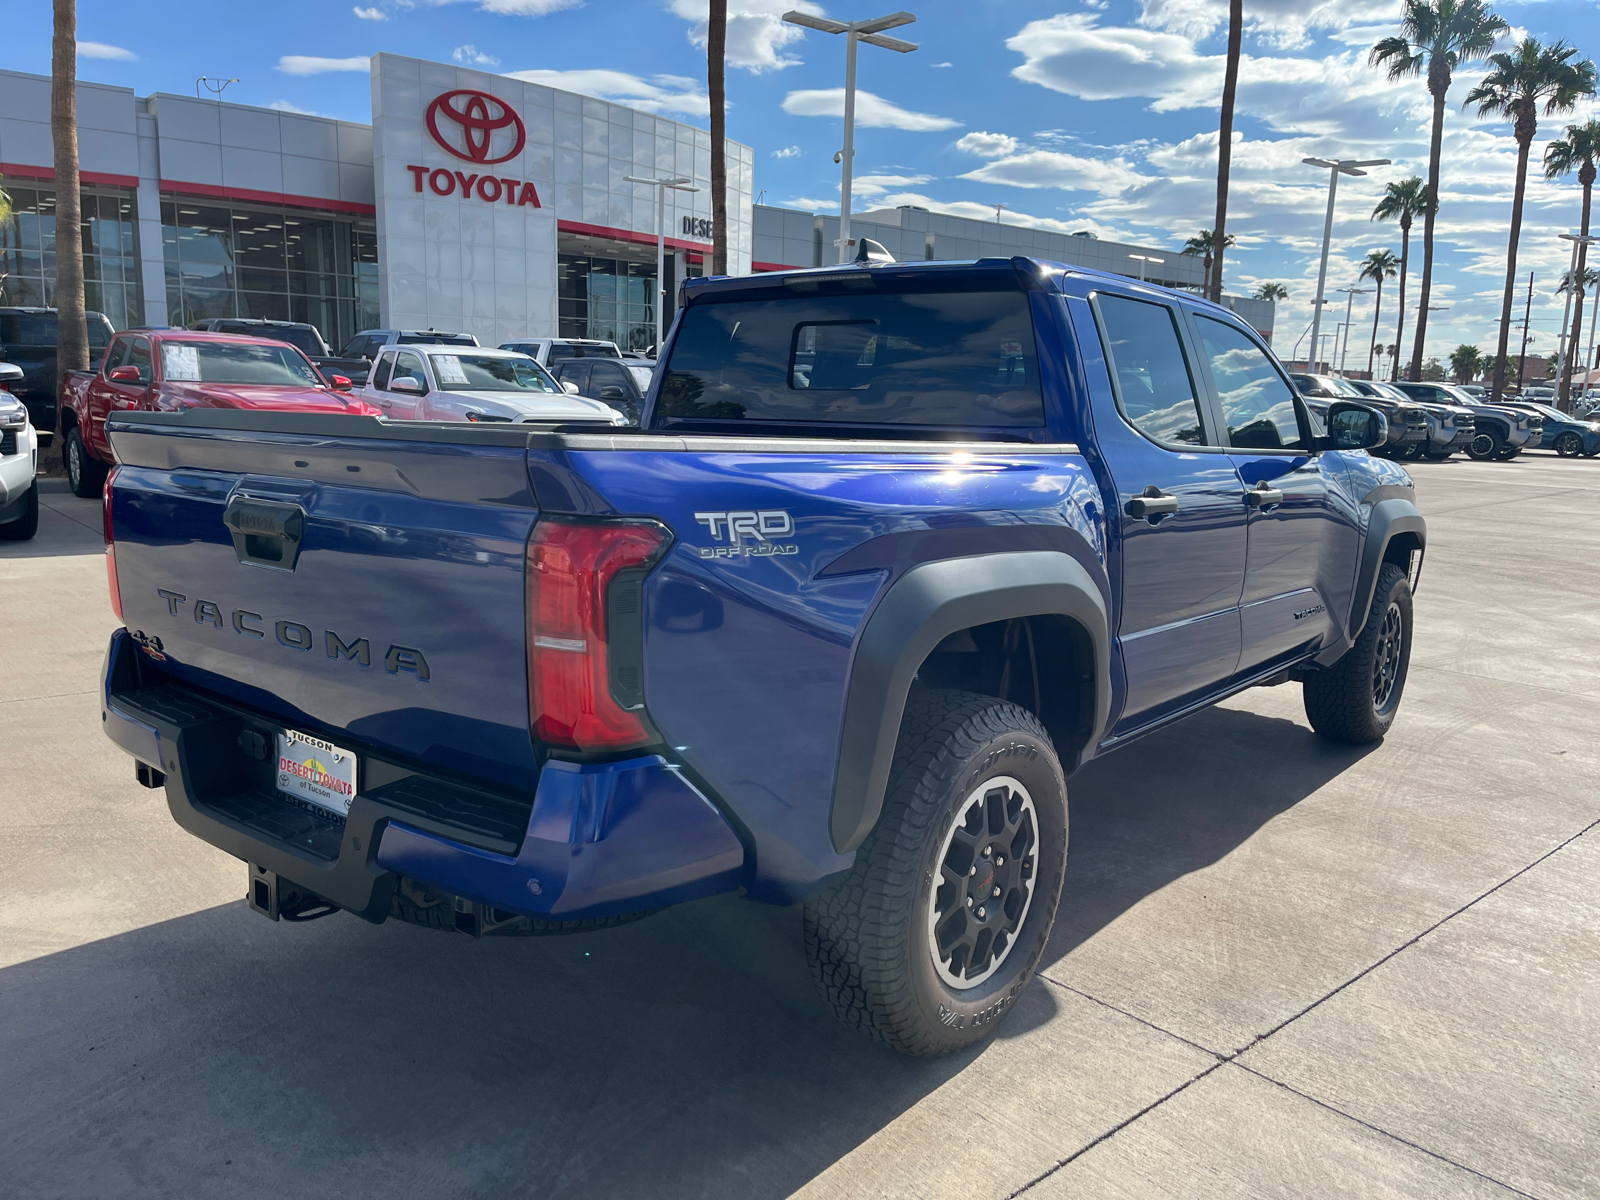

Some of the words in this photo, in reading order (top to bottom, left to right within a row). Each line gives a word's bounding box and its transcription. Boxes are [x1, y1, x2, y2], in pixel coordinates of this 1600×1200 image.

[407, 165, 541, 208] TOYOTA
[240, 513, 275, 530] TOYOTA
[694, 510, 795, 546] TRD
[699, 547, 741, 559] OFF
[744, 544, 799, 557] ROAD
[157, 588, 431, 682] TACOMA
[292, 731, 332, 752] TUCSON
[280, 757, 314, 781] DESERT
[317, 770, 352, 796] TOYOTA
[299, 781, 307, 789] of
[307, 782, 331, 799] Tucson
[277, 790, 308, 811] DESERT
[311, 804, 347, 827] TOYOT
